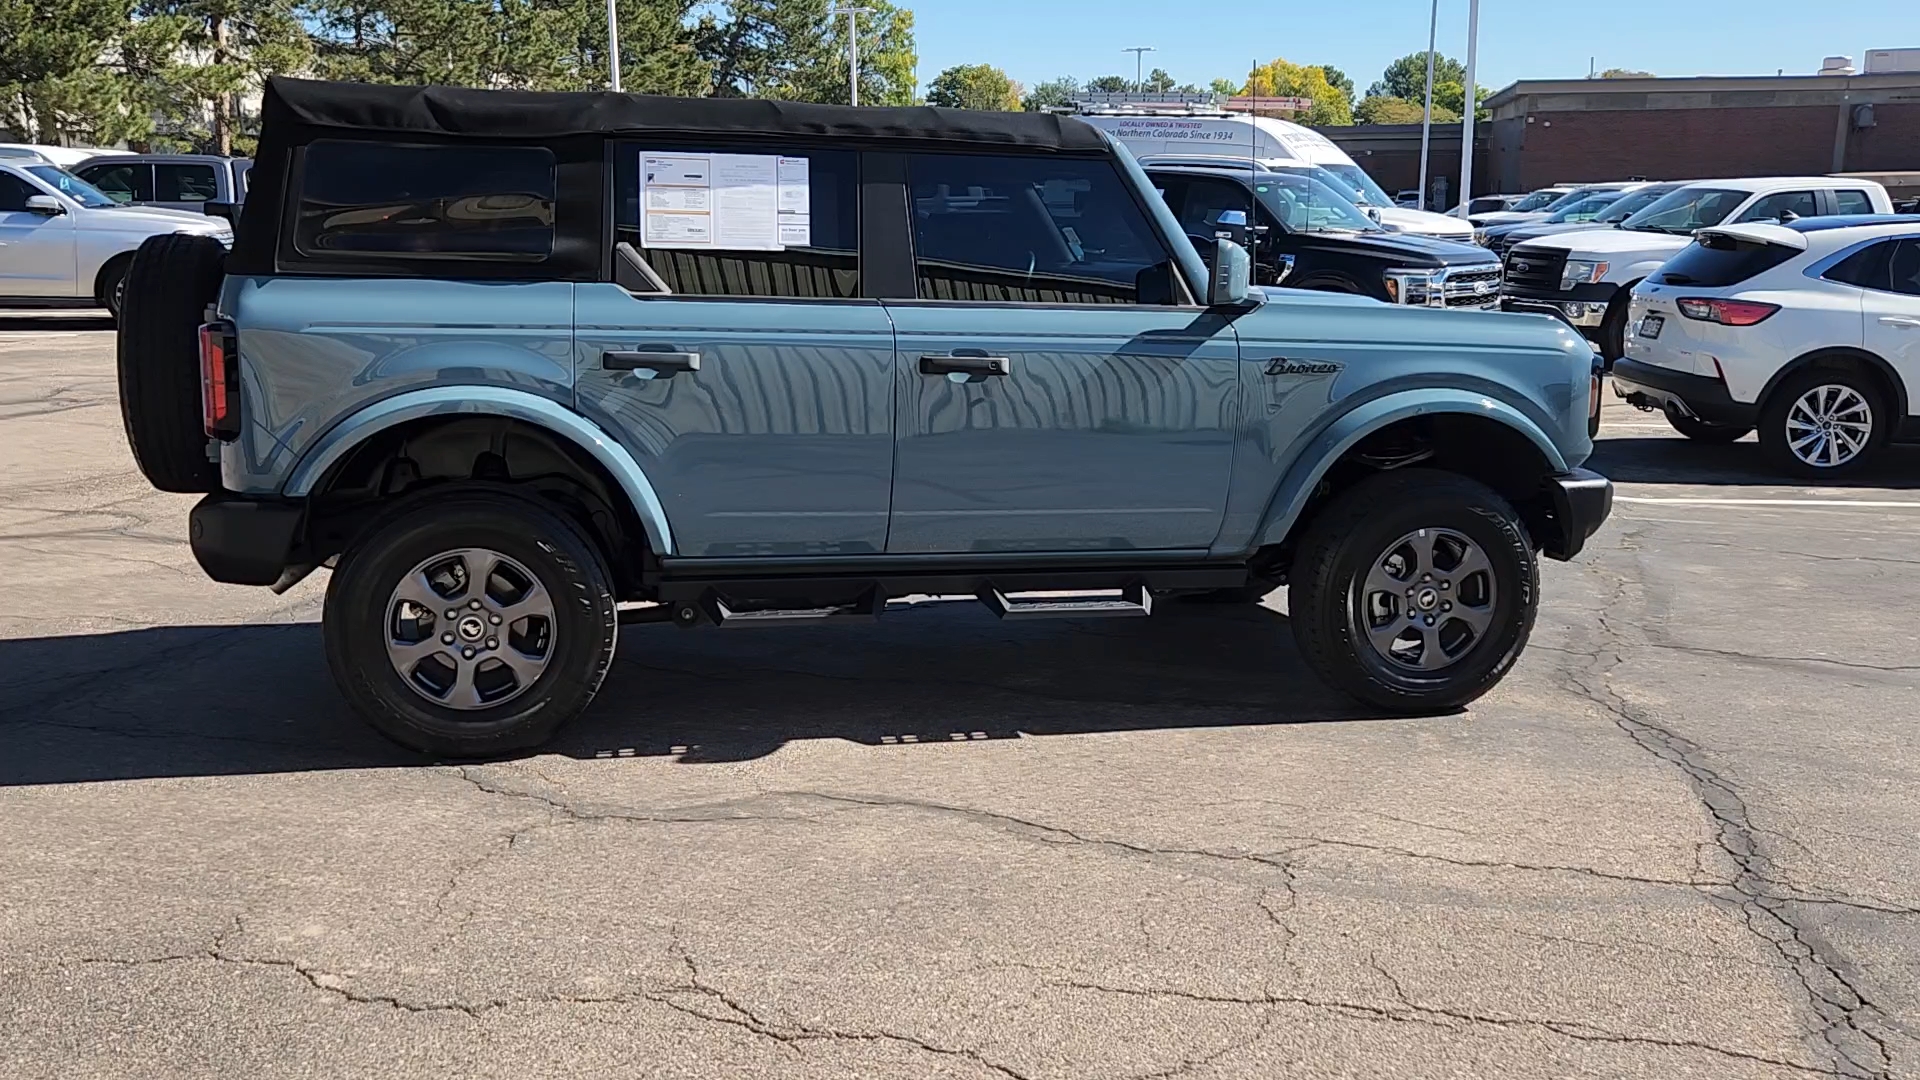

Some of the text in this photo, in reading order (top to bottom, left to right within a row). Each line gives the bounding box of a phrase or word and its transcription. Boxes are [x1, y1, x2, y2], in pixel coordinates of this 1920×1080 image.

[1119, 120, 1144, 128] LOCALLY
[1116, 128, 1151, 137] Northern
[1152, 129, 1189, 138] Colorado
[1190, 130, 1211, 140] Since
[1213, 131, 1234, 140] 1934
[1263, 356, 1345, 376] Bronco
